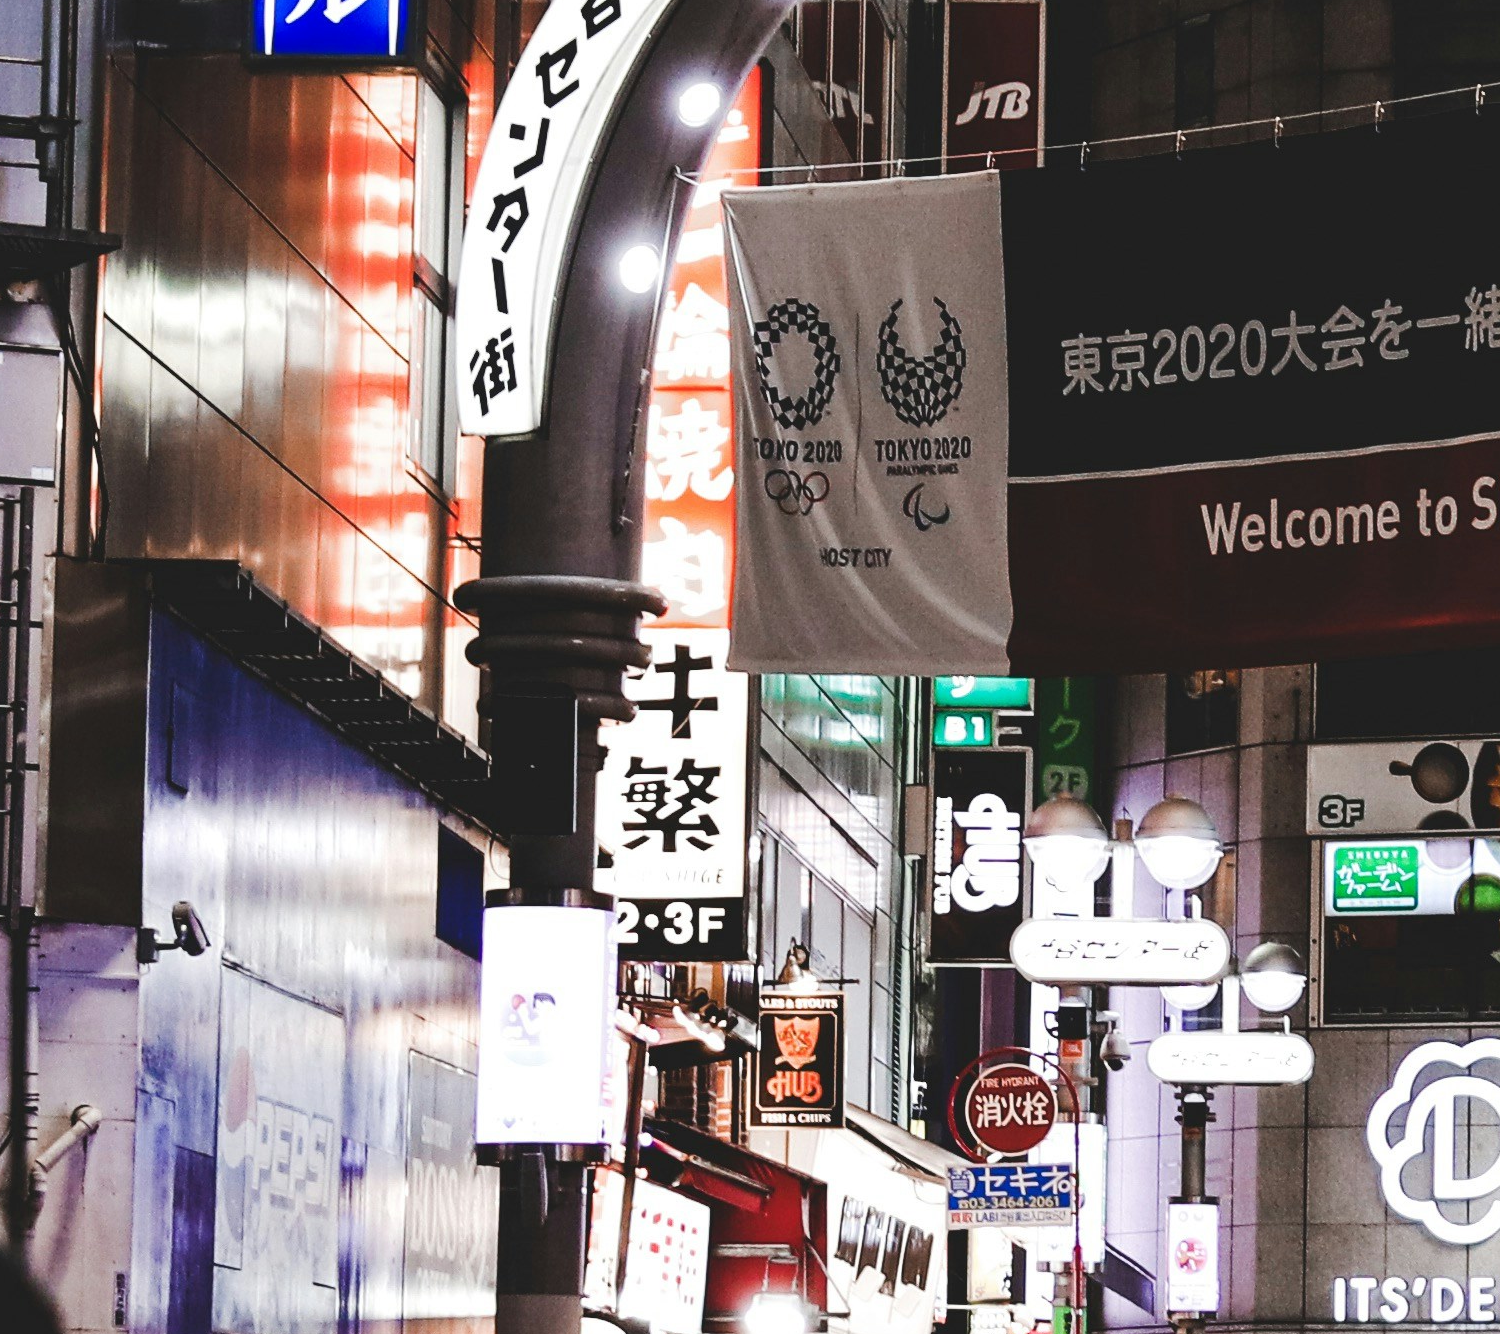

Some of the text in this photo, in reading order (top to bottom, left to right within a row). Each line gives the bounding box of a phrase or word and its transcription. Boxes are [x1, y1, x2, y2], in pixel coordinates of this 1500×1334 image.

[955, 81, 1031, 126] JTB
[803, 440, 842, 463] 2020
[874, 436, 971, 462] TOKYO 2020
[1201, 497, 1399, 556] Welcome
[1415, 493, 1459, 540] to
[820, 547, 892, 567] HOST CITY
[945, 715, 985, 742] B1
[620, 644, 721, 853] 牛繁
[1318, 795, 1365, 828] 3F
[951, 792, 1021, 912] HUB
[766, 1071, 823, 1104] HUB
[981, 1076, 1041, 1088] FIRE HYDRANT
[975, 1091, 1050, 1129] 消火栓
[978, 1167, 1074, 1197] セキネ
[969, 1197, 1061, 1210] 03-3464-2061
